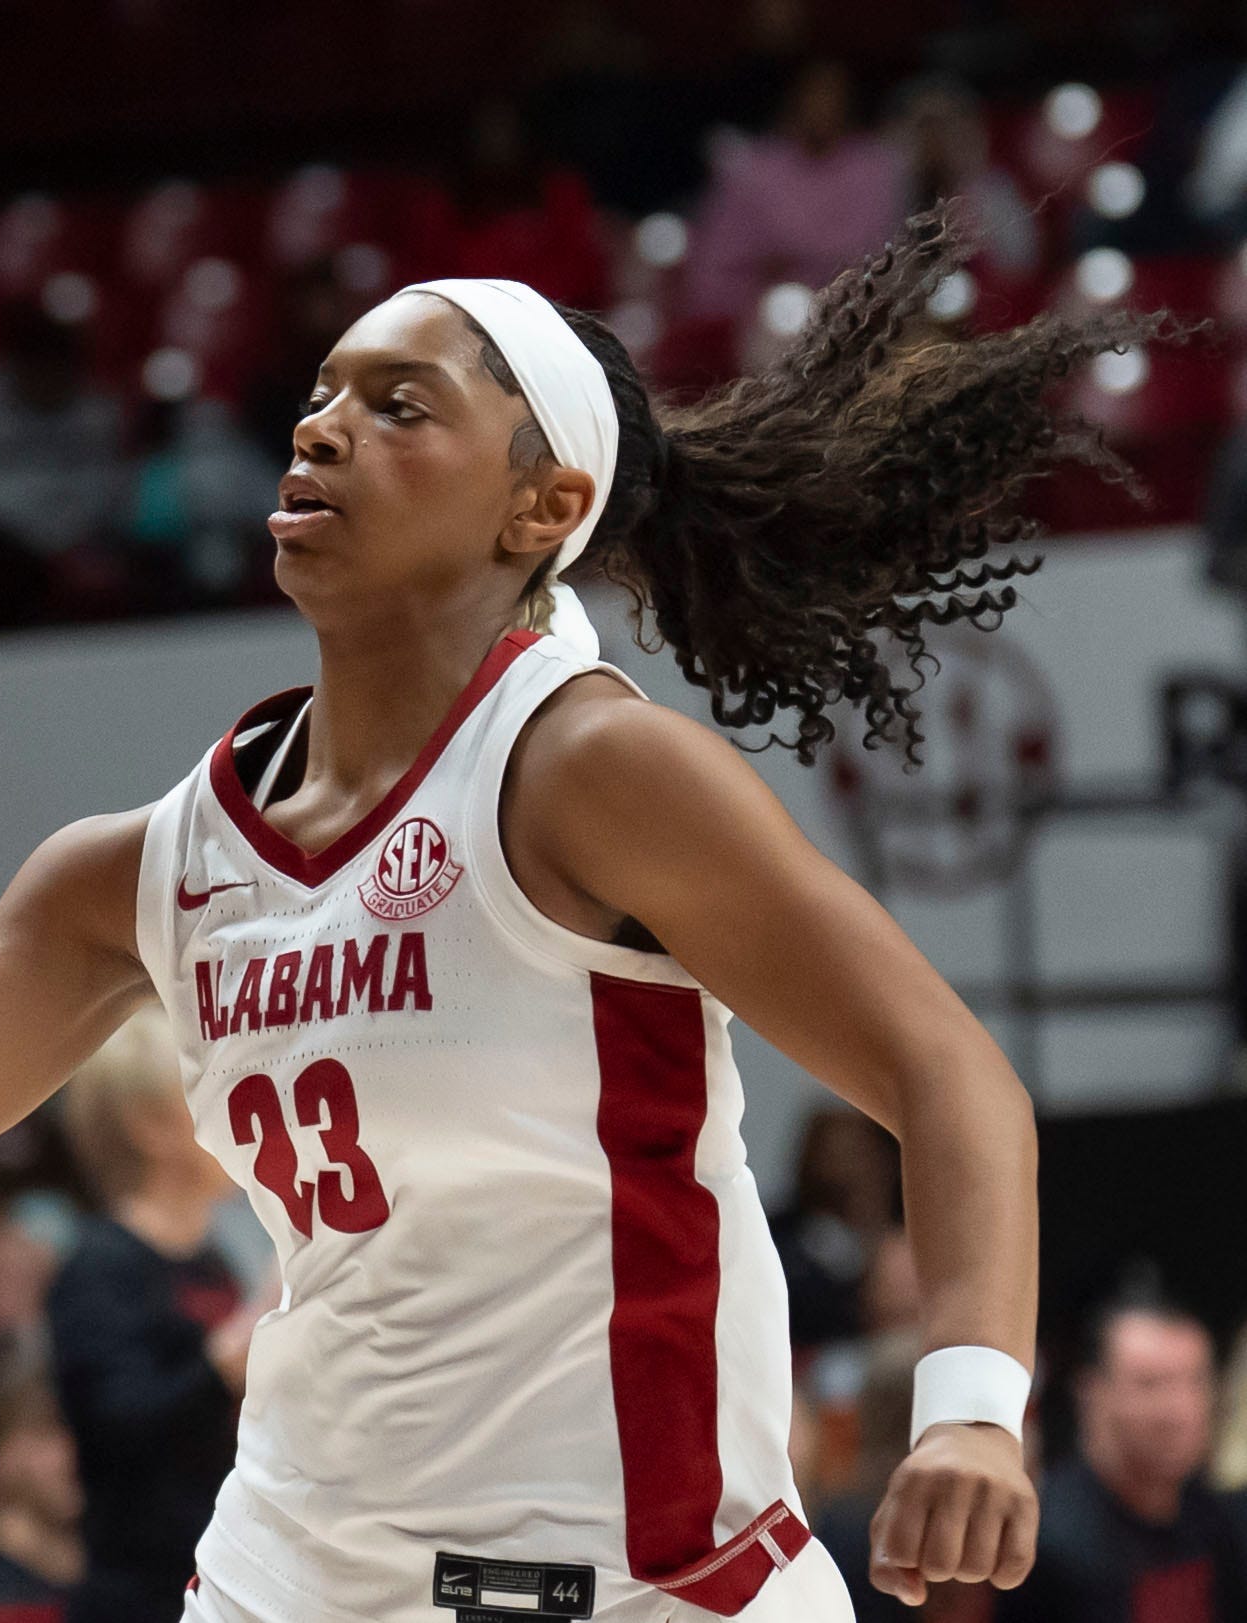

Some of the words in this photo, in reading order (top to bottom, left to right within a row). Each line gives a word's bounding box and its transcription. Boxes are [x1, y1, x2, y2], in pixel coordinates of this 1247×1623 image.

[382, 821, 442, 893] SEC
[367, 881, 447, 917] GRADUATE
[195, 931, 433, 1041] ALABAMA
[228, 1058, 390, 1240] 23
[440, 1584, 473, 1597] ELITE
[552, 1581, 579, 1603] 44
